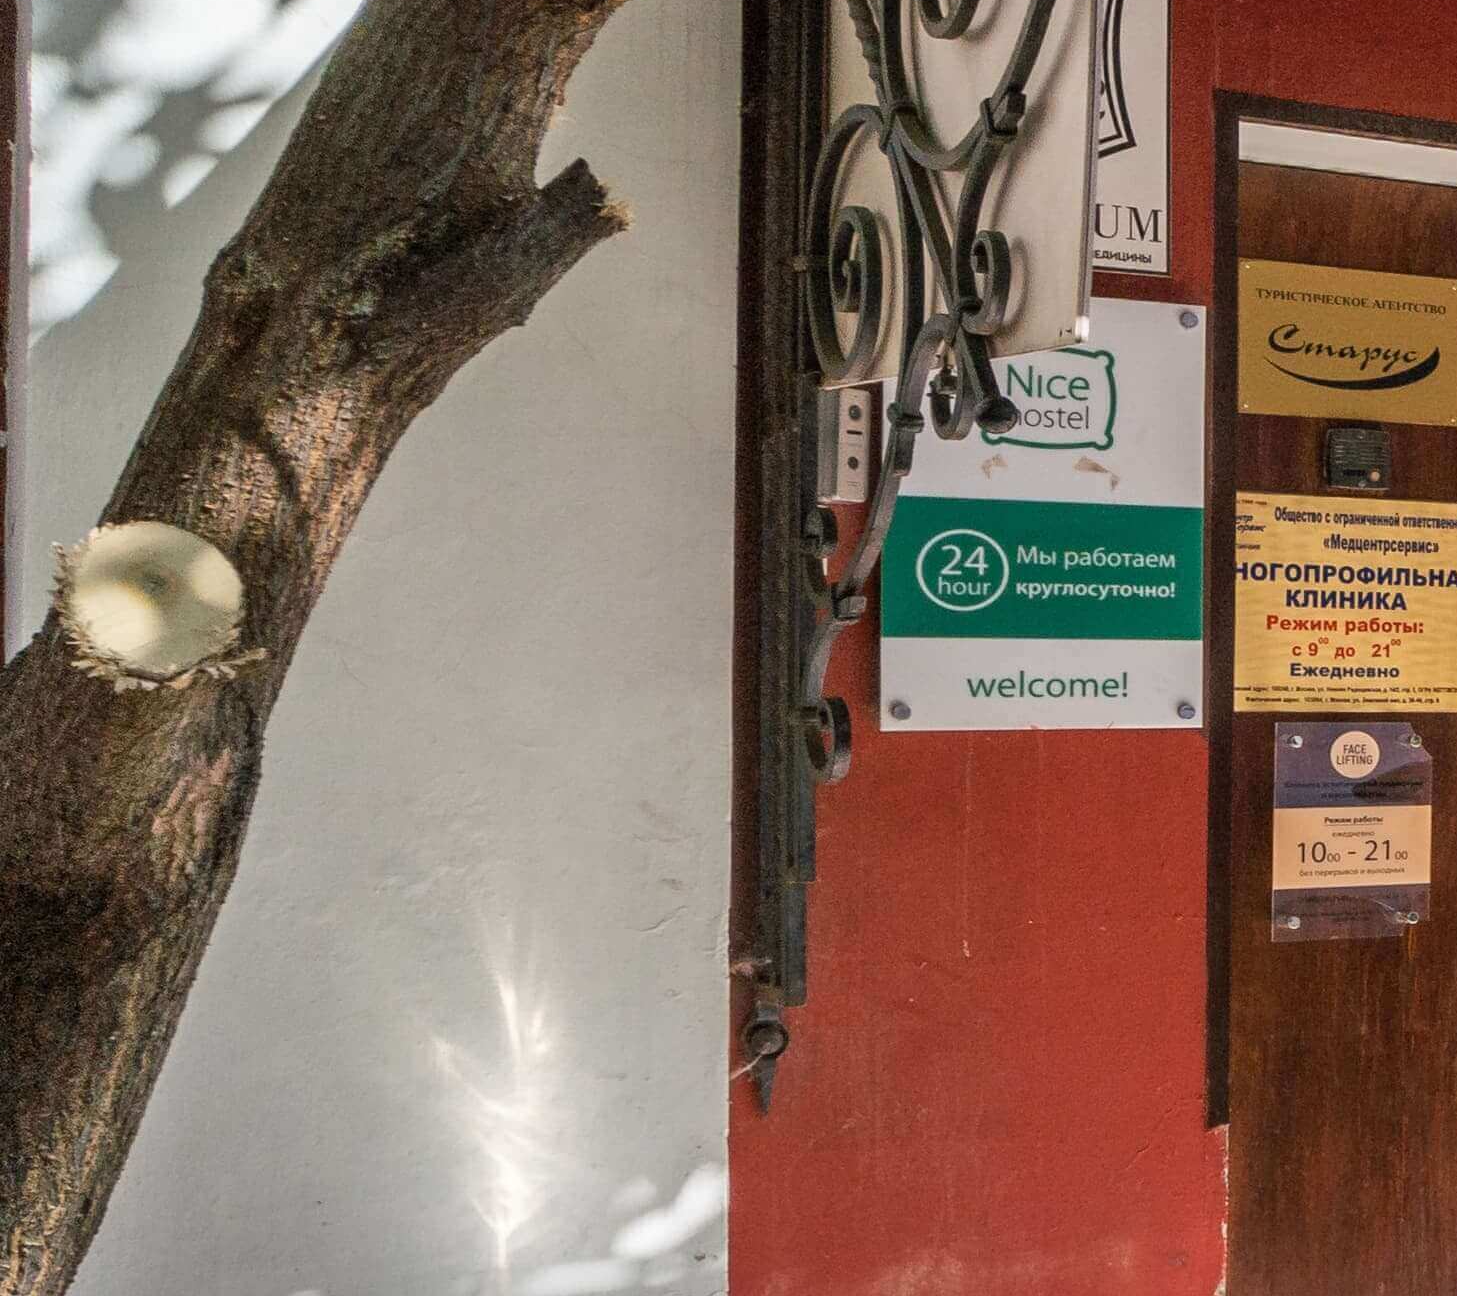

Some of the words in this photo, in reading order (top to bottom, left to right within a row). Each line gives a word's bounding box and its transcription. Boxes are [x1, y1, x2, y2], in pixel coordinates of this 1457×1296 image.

[1094, 249, 1152, 264] ЕДИЦИНЫ
[1256, 287, 1368, 308] ТУРИСТИЧЕСКОЕ
[1372, 299, 1446, 315] АГЕНТСТВО
[1268, 323, 1418, 373] Старус
[1275, 506, 1323, 524] Общество
[1333, 511, 1400, 527] ограниченной
[1323, 534, 1439, 555] «Медцентрсервис»
[940, 544, 989, 575] 24
[1017, 545, 1056, 565] Мы
[1064, 547, 1176, 571] работаем
[937, 576, 991, 596] hour
[1016, 582, 1176, 601] круглосуточно!
[1285, 589, 1407, 611] КЛИНИКА
[1266, 614, 1338, 632] Режим
[1345, 617, 1424, 635] работы:
[1292, 646, 1301, 656] с
[1334, 645, 1355, 659] до
[1290, 662, 1400, 679] Ежедневно
[967, 670, 1128, 698] welcome!
[1343, 744, 1367, 754] FACE
[1336, 755, 1373, 765] LIFTING
